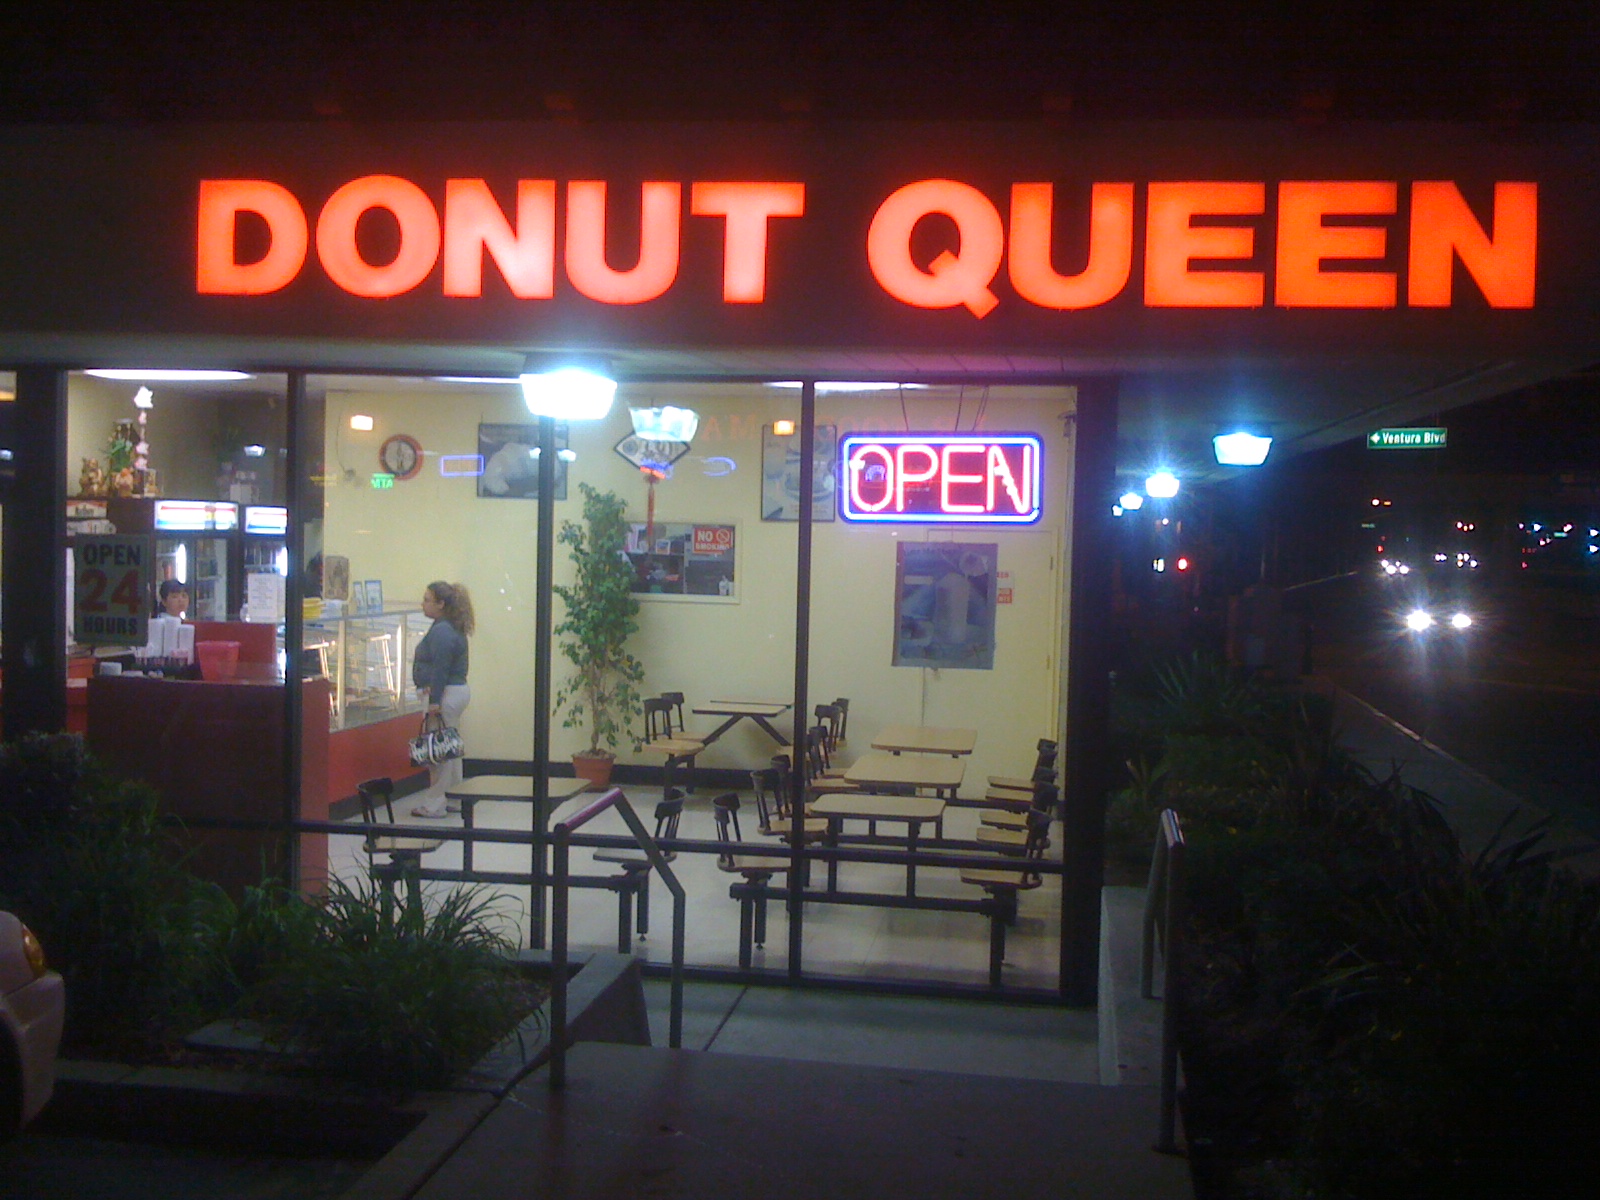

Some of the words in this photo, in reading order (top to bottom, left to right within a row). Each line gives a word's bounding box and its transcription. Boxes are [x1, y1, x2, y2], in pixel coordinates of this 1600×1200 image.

[196, 175, 806, 304] DONUT
[867, 179, 1538, 318] QUEEN
[1382, 432, 1421, 444] Ventura
[1424, 431, 1446, 444] Blvd
[849, 443, 1034, 514] OPEN
[697, 530, 713, 542] NO
[83, 543, 141, 566] OPEN
[80, 569, 142, 615] 24
[83, 616, 138, 636] HOURS
